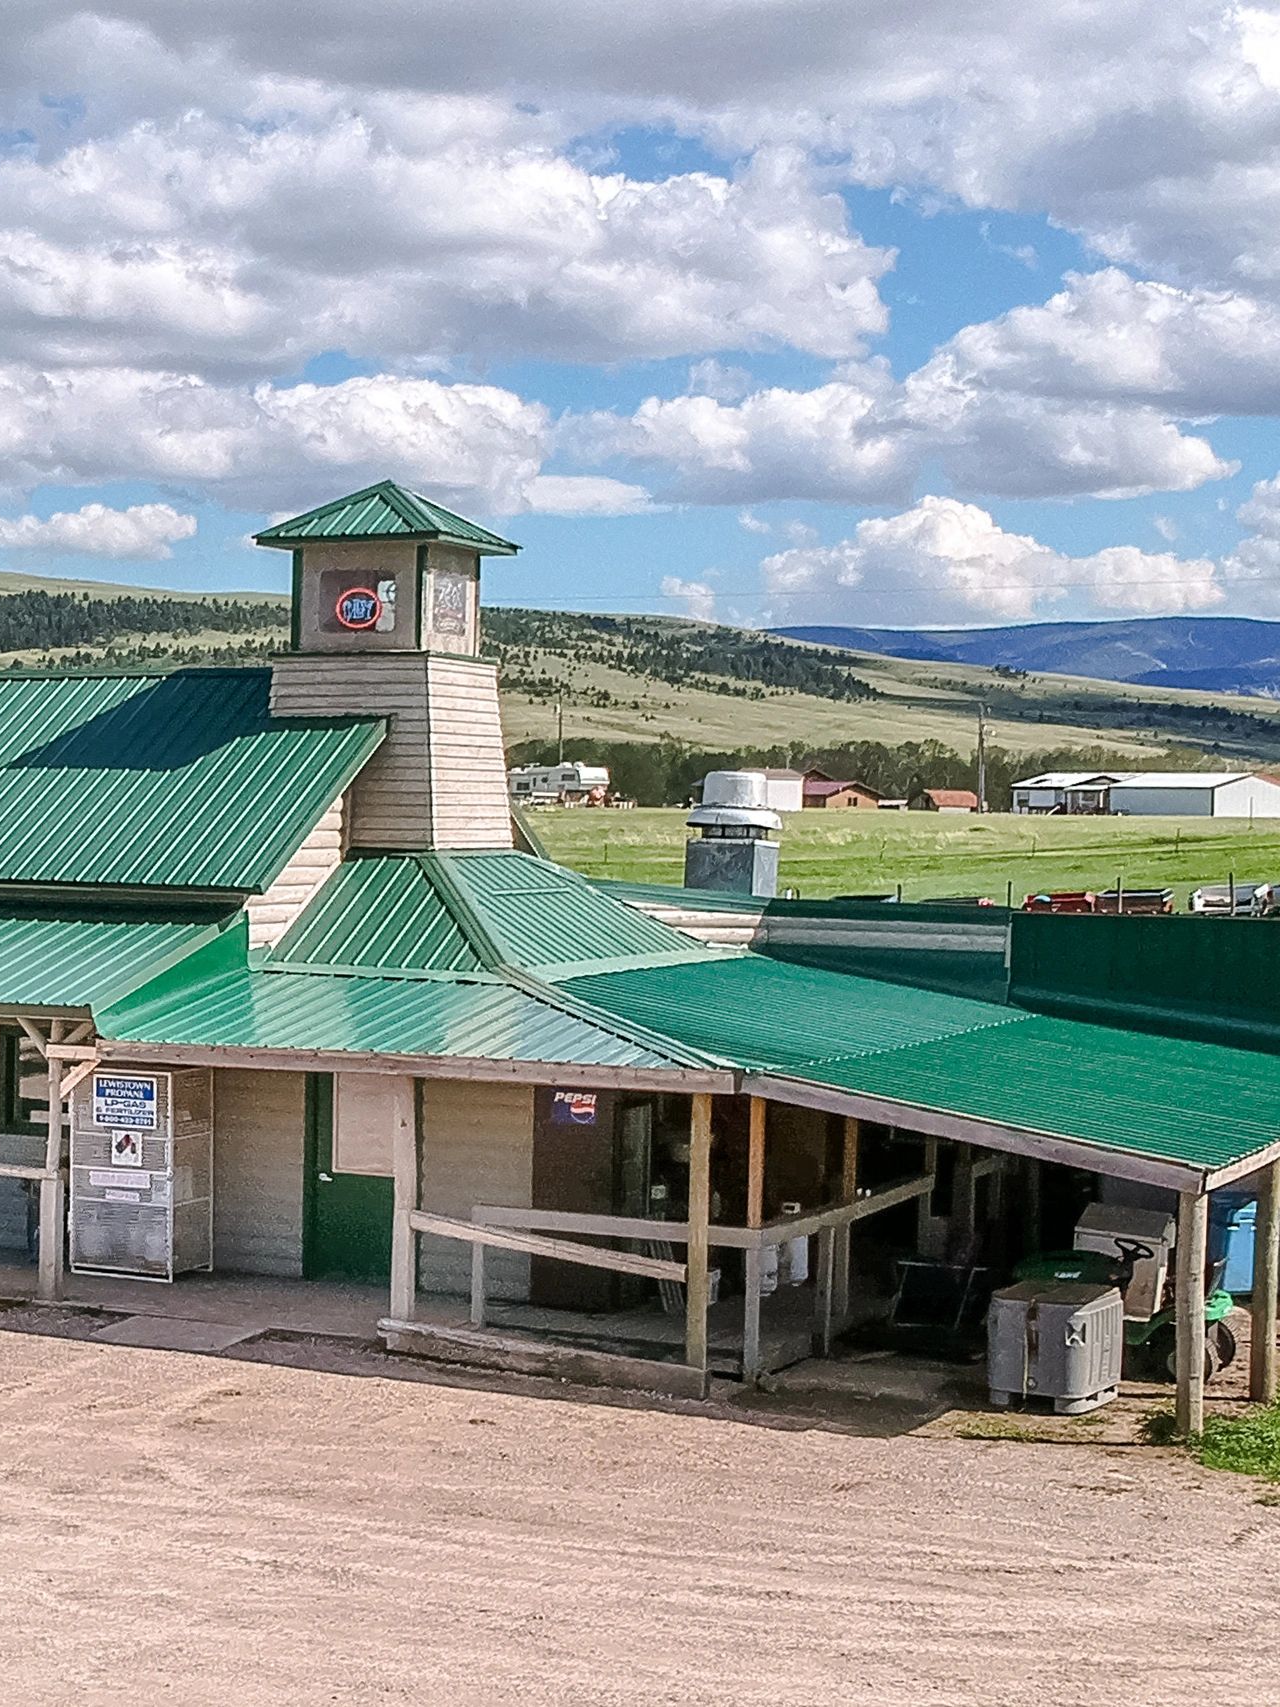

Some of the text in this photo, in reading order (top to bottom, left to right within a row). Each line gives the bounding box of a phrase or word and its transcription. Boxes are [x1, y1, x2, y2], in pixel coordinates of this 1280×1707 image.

[99, 1079, 151, 1090] LEWISTOWN
[105, 1088, 145, 1099] PROPANE
[554, 1091, 597, 1105] PEPSI
[104, 1099, 147, 1109] LP-GAS
[105, 1107, 154, 1117] FERTILIZER
